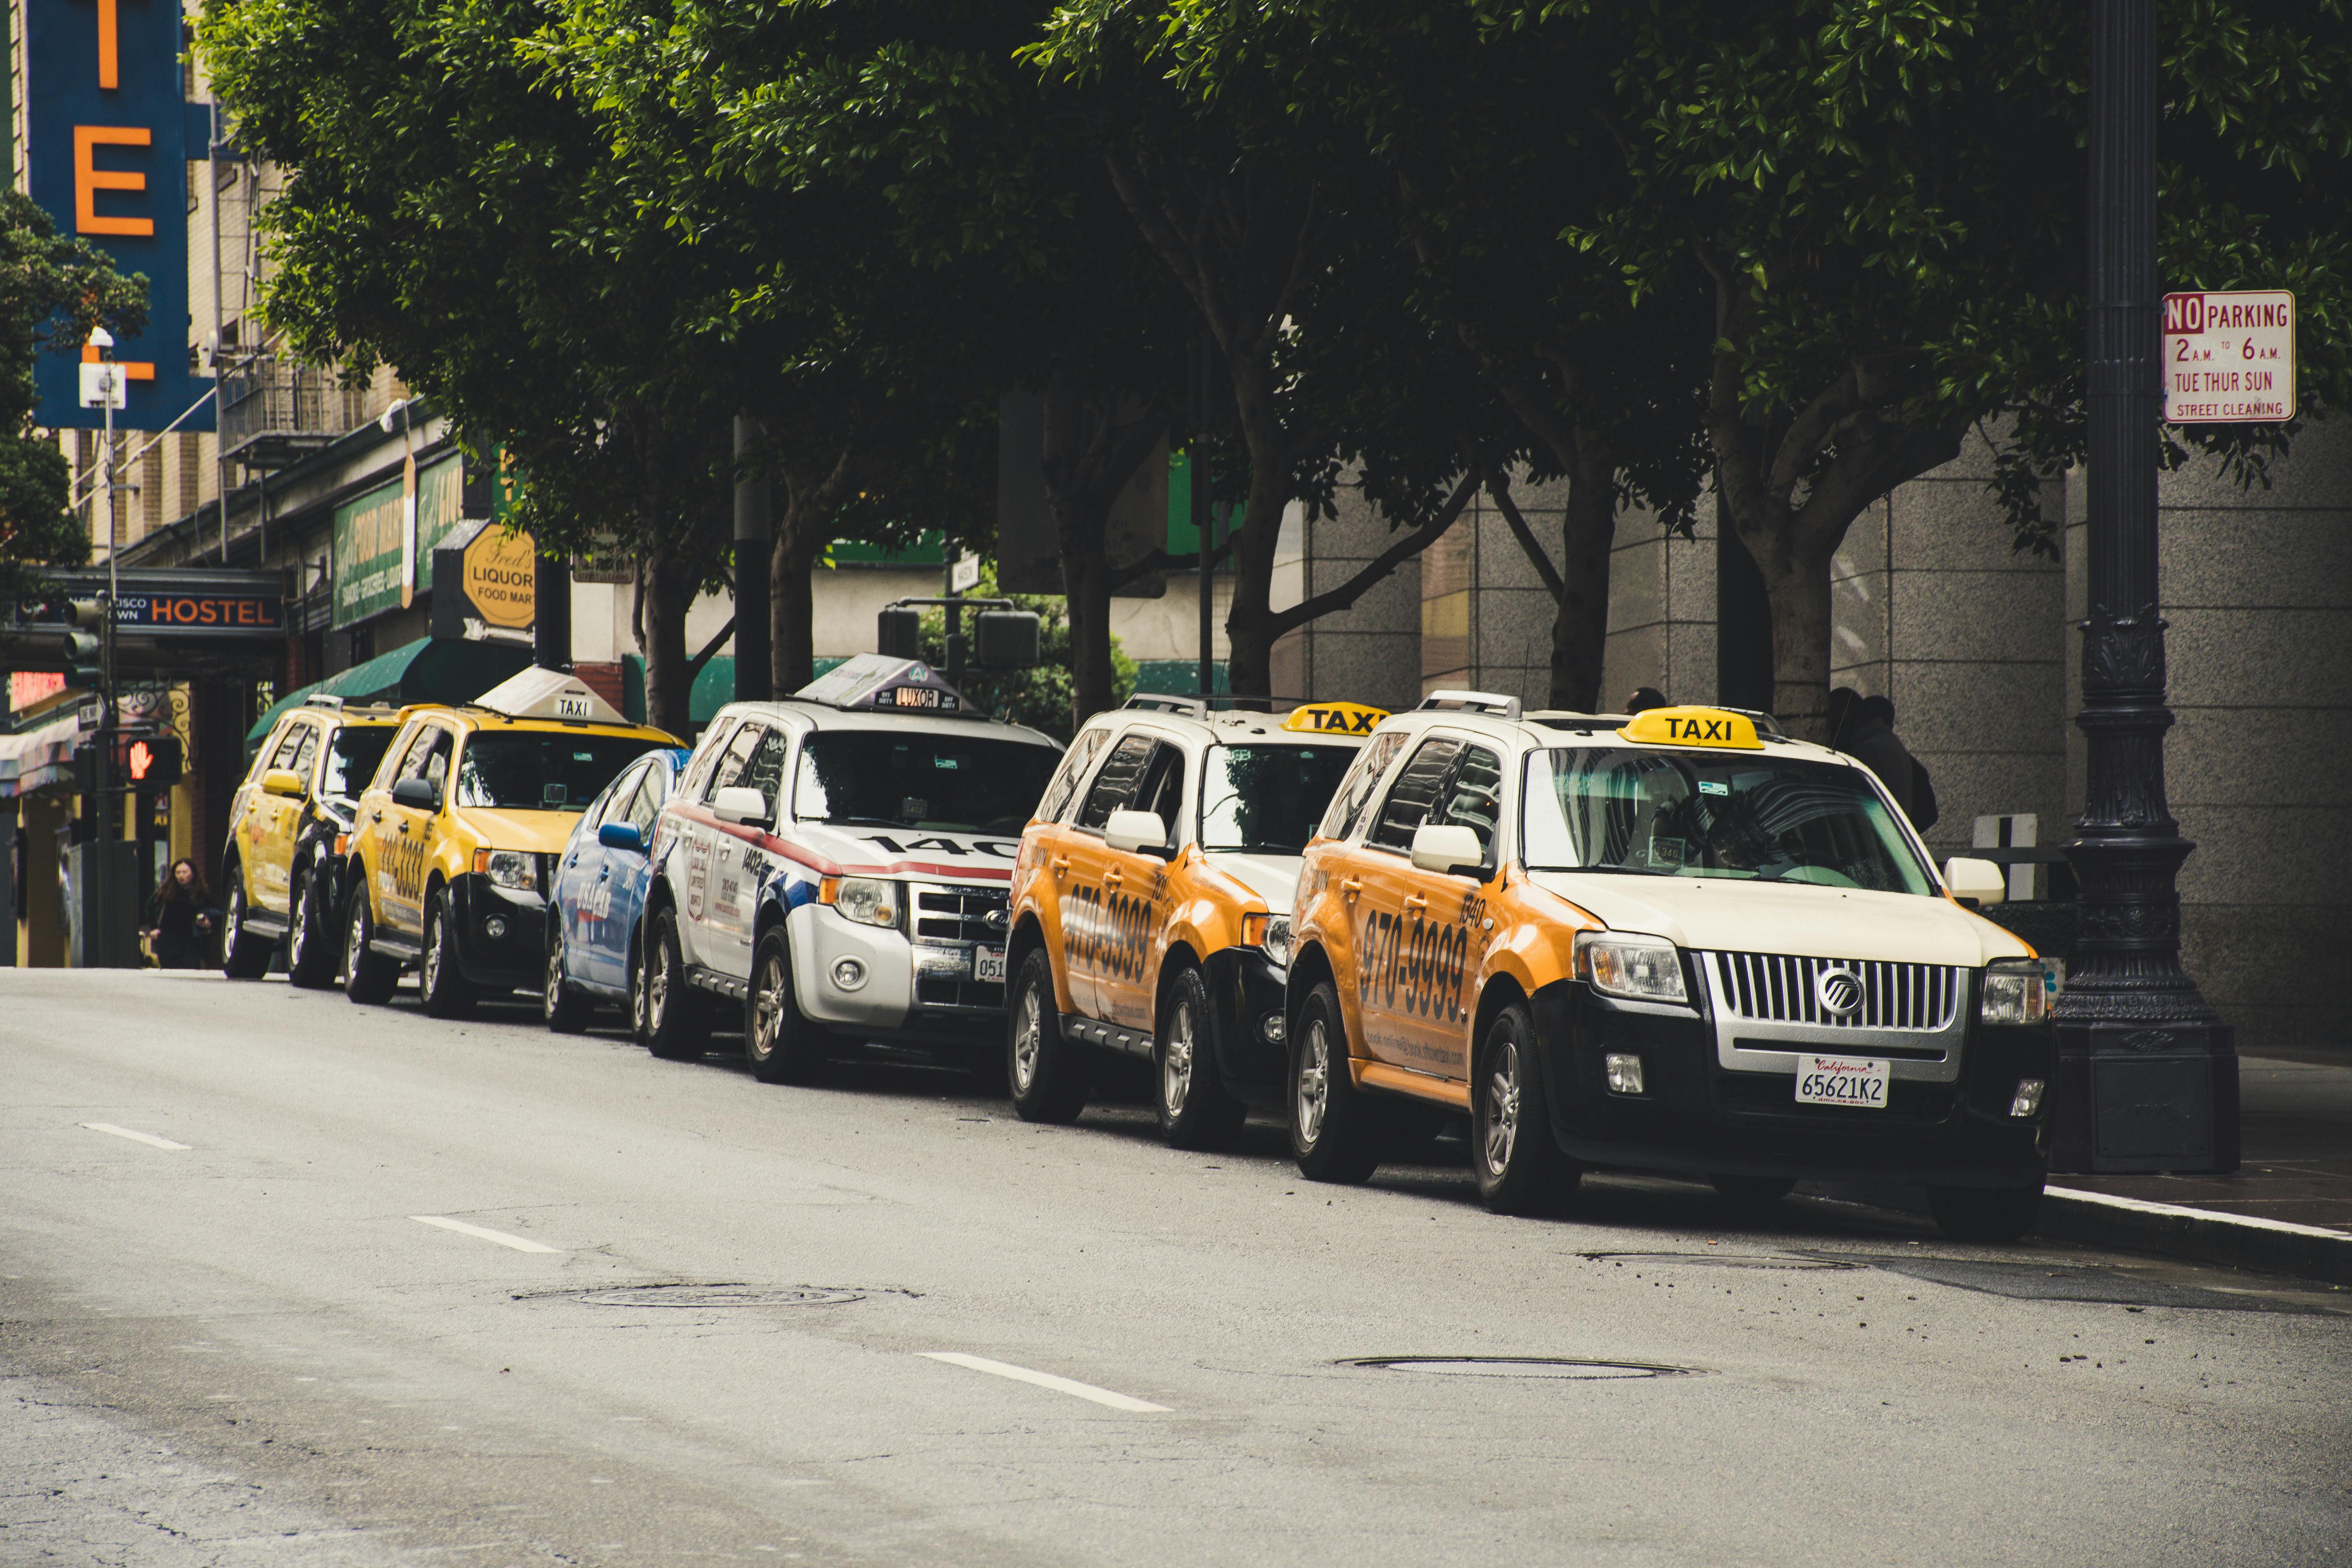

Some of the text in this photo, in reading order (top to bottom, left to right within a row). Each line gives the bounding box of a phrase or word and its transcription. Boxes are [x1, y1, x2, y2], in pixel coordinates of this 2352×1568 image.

[2167, 297, 2287, 330] NO PARKING
[2176, 337, 2281, 362] 2 A.M. TO 6 A.M.
[2175, 371, 2272, 392] TUE THUR SUN
[2178, 402, 2282, 416] STREET CLEANING
[486, 543, 531, 569] Fred's
[474, 567, 533, 588] LIQUOR
[478, 587, 534, 604] FOOD MAR
[152, 598, 274, 624] HOSTEL
[560, 700, 587, 716] TAXI
[901, 688, 934, 707] LUXOR
[1665, 718, 1731, 740] TAXI
[742, 847, 762, 877] 1402
[1459, 893, 1486, 928] 1340
[1064, 883, 1152, 984] 970-9999
[980, 959, 1004, 977] 051
[1360, 909, 1467, 1023] 970-9999
[1817, 1060, 1871, 1075] California
[1802, 1073, 1882, 1100] 65621K2
